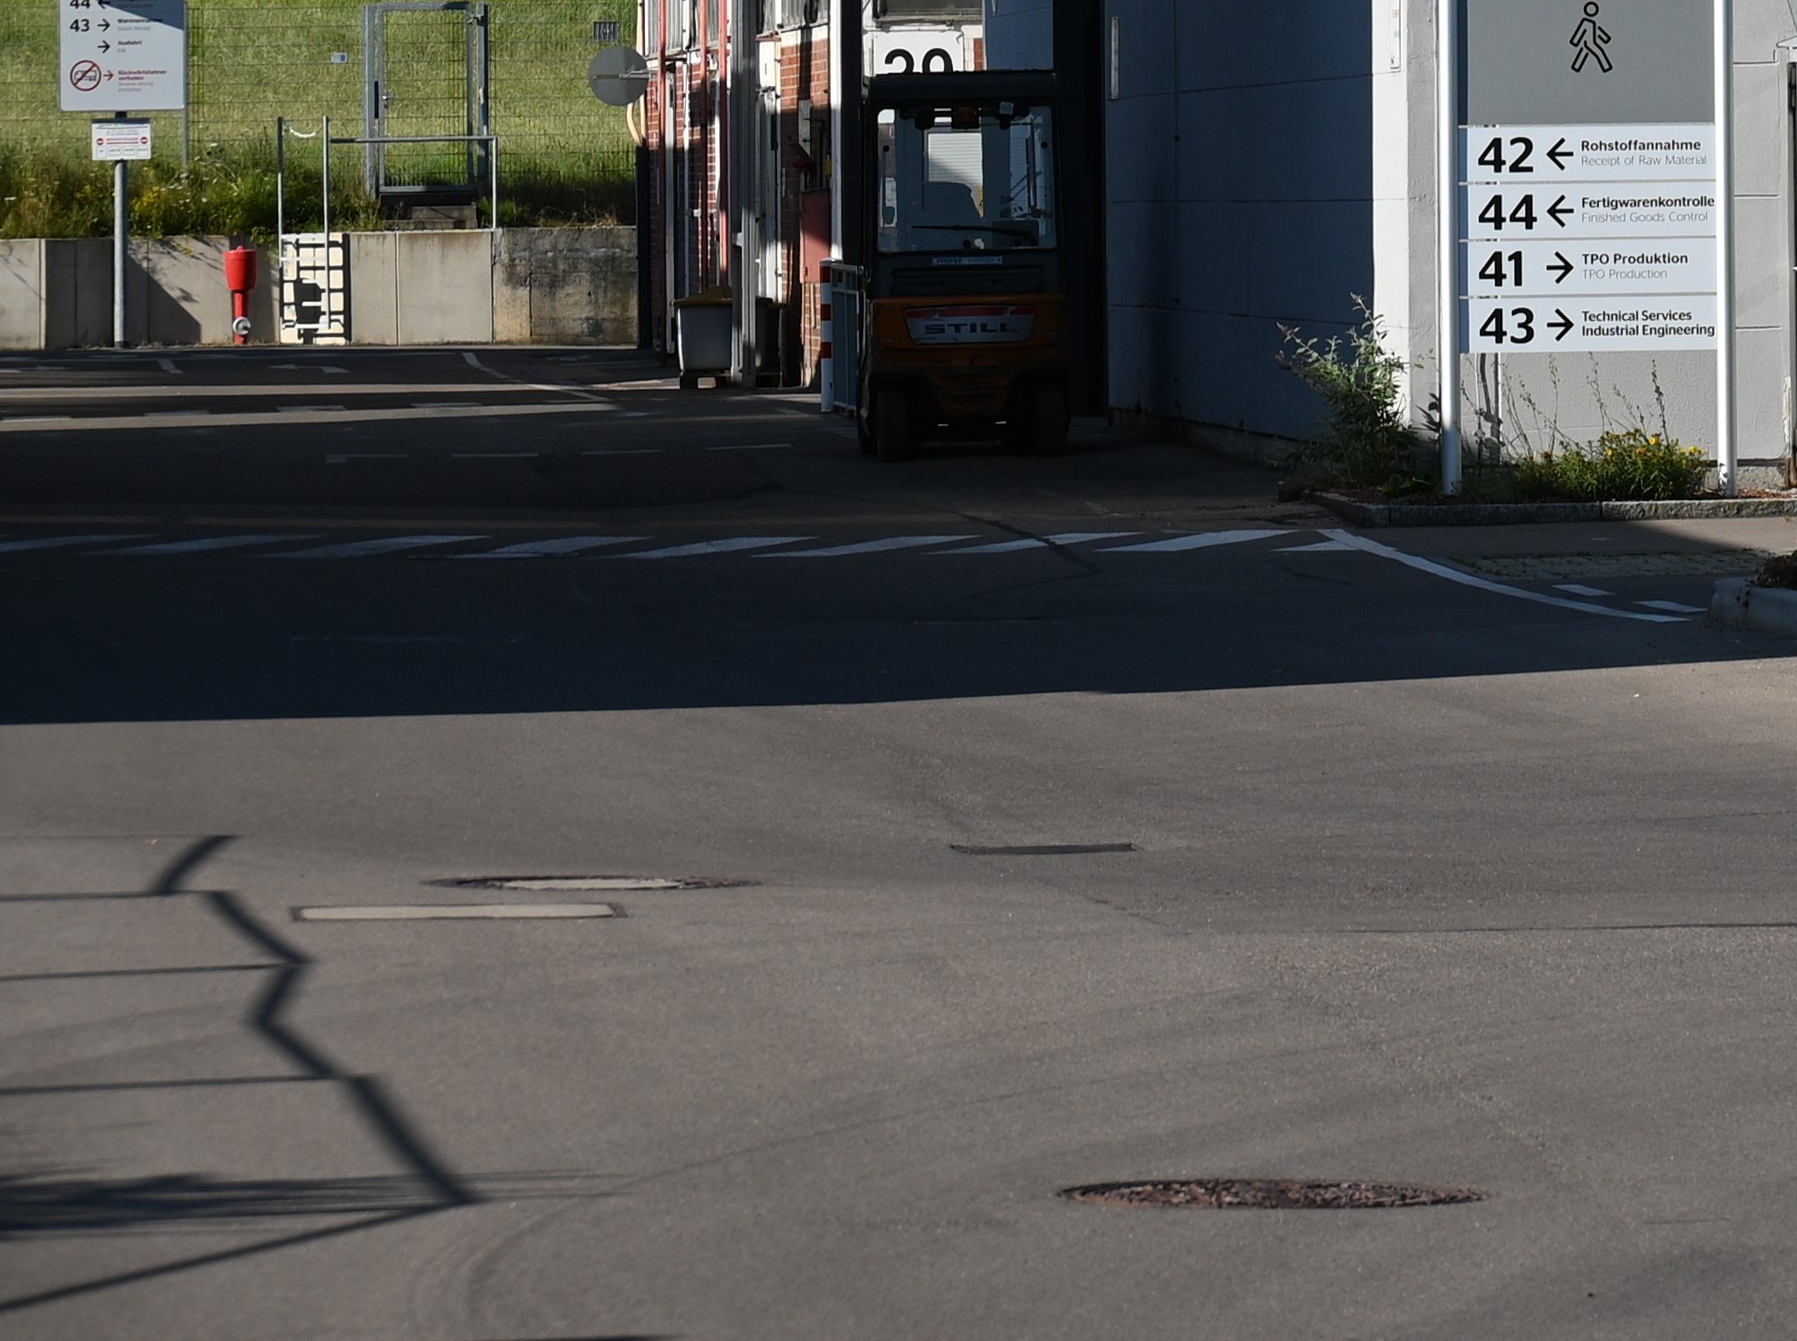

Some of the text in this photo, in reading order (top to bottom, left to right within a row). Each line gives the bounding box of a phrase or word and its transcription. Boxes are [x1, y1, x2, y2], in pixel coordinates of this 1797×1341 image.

[69, 19, 90, 32] 43
[1478, 137, 1701, 173] 42 Rohstoffannahme
[1581, 155, 1707, 167] Receipt of Raw Material
[1478, 194, 1715, 231] 44 Fertigwarenkontrolle
[1582, 212, 1709, 223] Finished Goods Control
[1478, 251, 1688, 287] 41 TPO Produktion
[1582, 268, 1668, 279] TPO Production
[925, 321, 1018, 335] STILL
[1479, 307, 1692, 344] 43 Technical Services
[1582, 324, 1715, 338] Industrial Engineering
